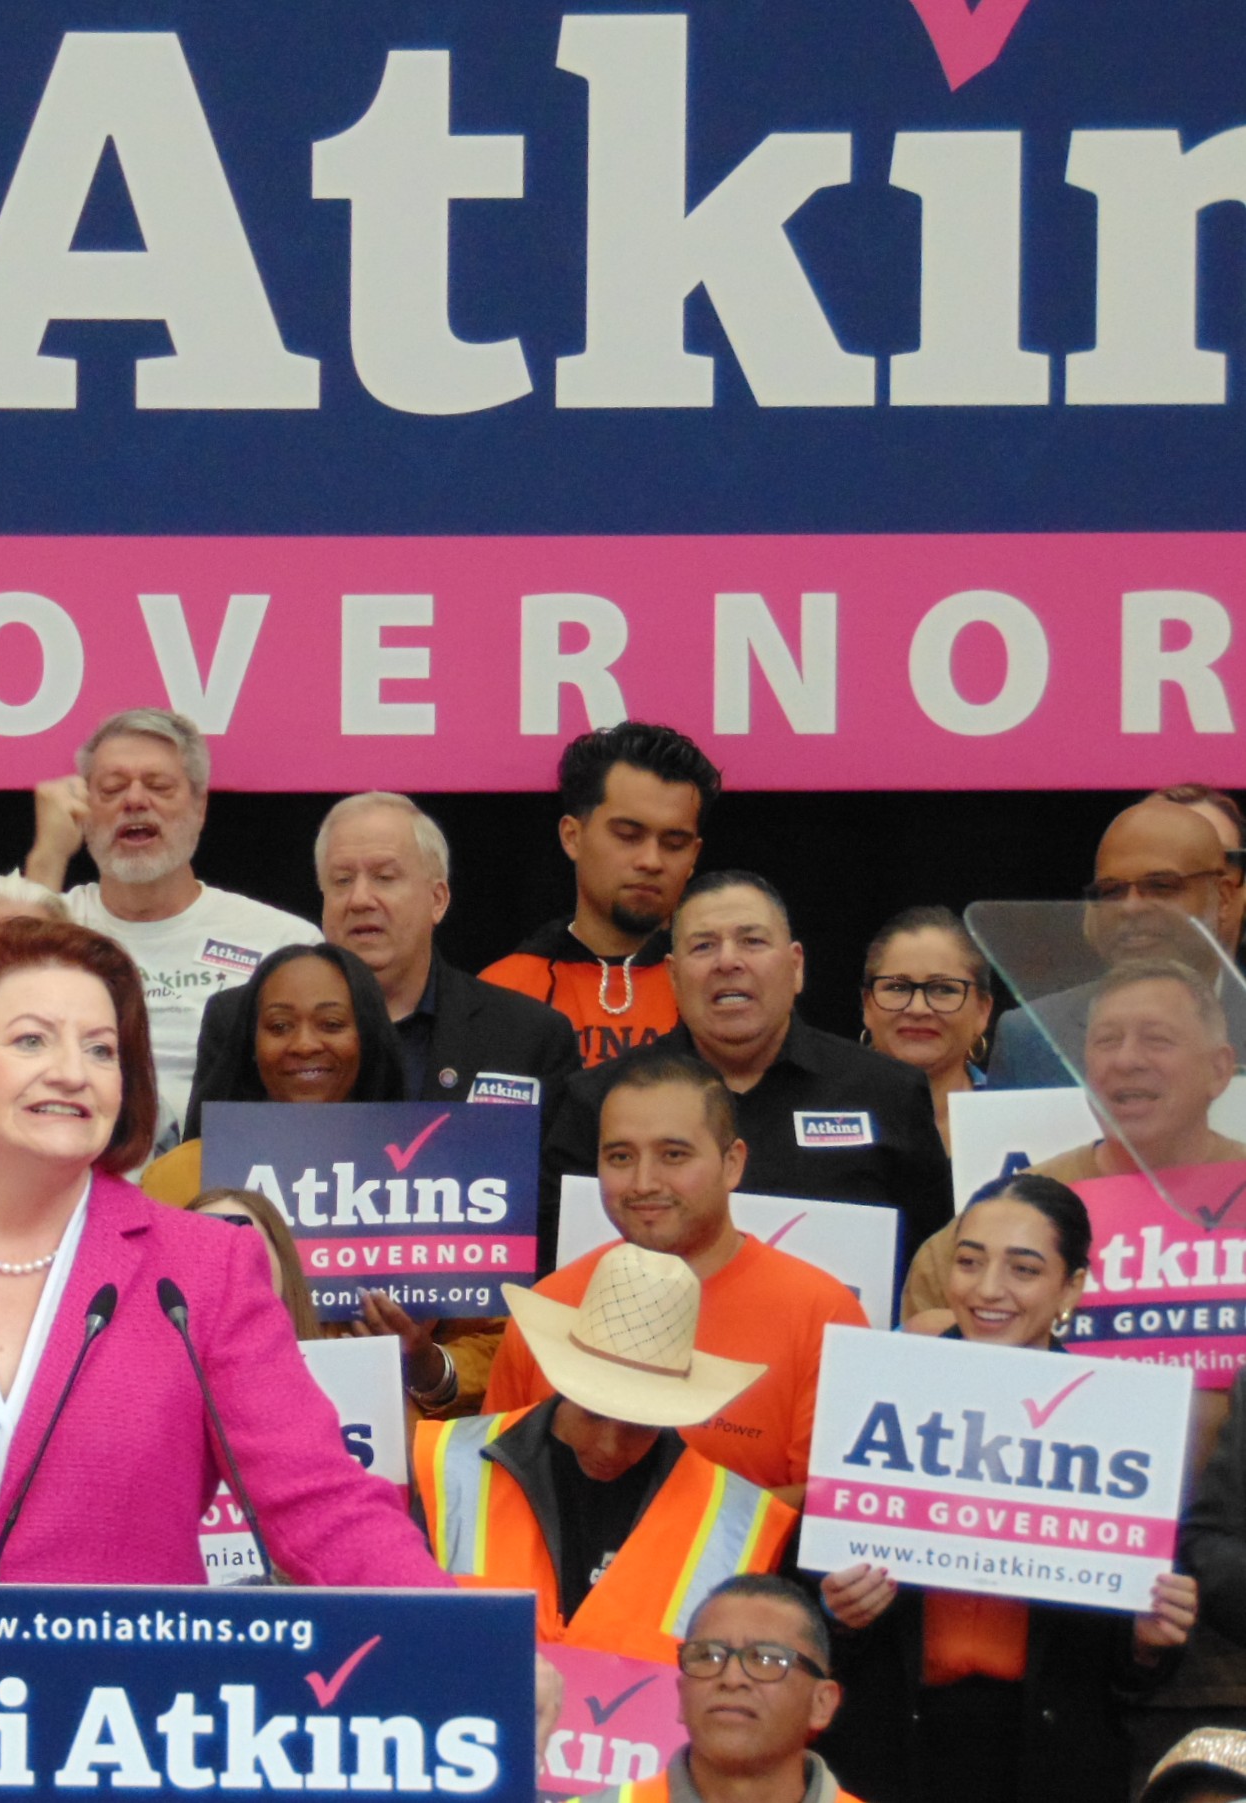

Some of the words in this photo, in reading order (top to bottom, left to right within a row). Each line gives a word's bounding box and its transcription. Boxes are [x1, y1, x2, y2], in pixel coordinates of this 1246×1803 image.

[476, 1082, 531, 1101] Atkins
[806, 1121, 861, 1135] Atkins
[243, 1162, 508, 1228] Atkins
[310, 1244, 508, 1269] GOVERNOR
[1113, 1306, 1246, 1334] GOVER
[843, 1401, 1151, 1499] Atkins
[834, 1488, 906, 1519] FOR
[928, 1502, 1146, 1549] GOVERNOR
[849, 1539, 1123, 1593] www.toniatkins.org
[54, 1684, 499, 1793] Atkins
